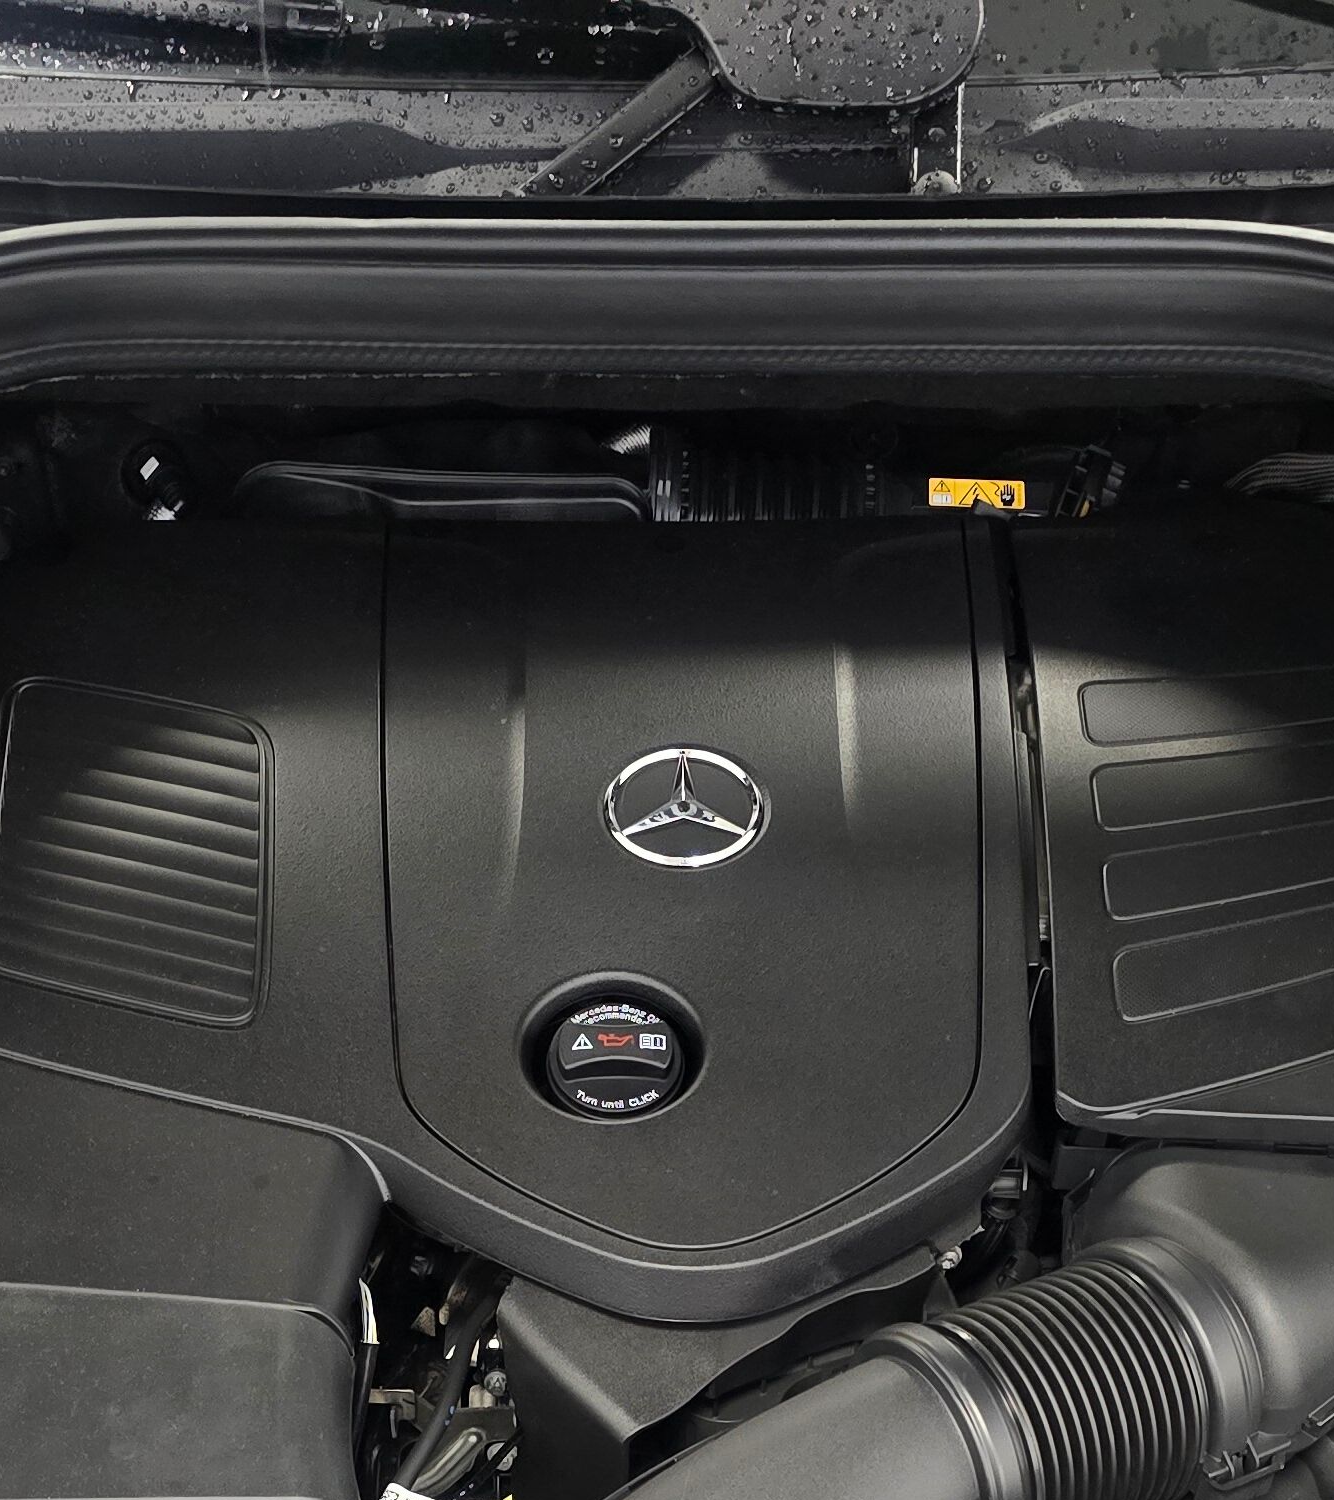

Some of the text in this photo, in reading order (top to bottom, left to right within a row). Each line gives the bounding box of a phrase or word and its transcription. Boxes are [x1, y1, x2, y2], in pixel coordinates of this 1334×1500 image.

[571, 1004, 647, 1024] Mercedes-Benz
[576, 1090, 660, 1109] Turn until CLICK
